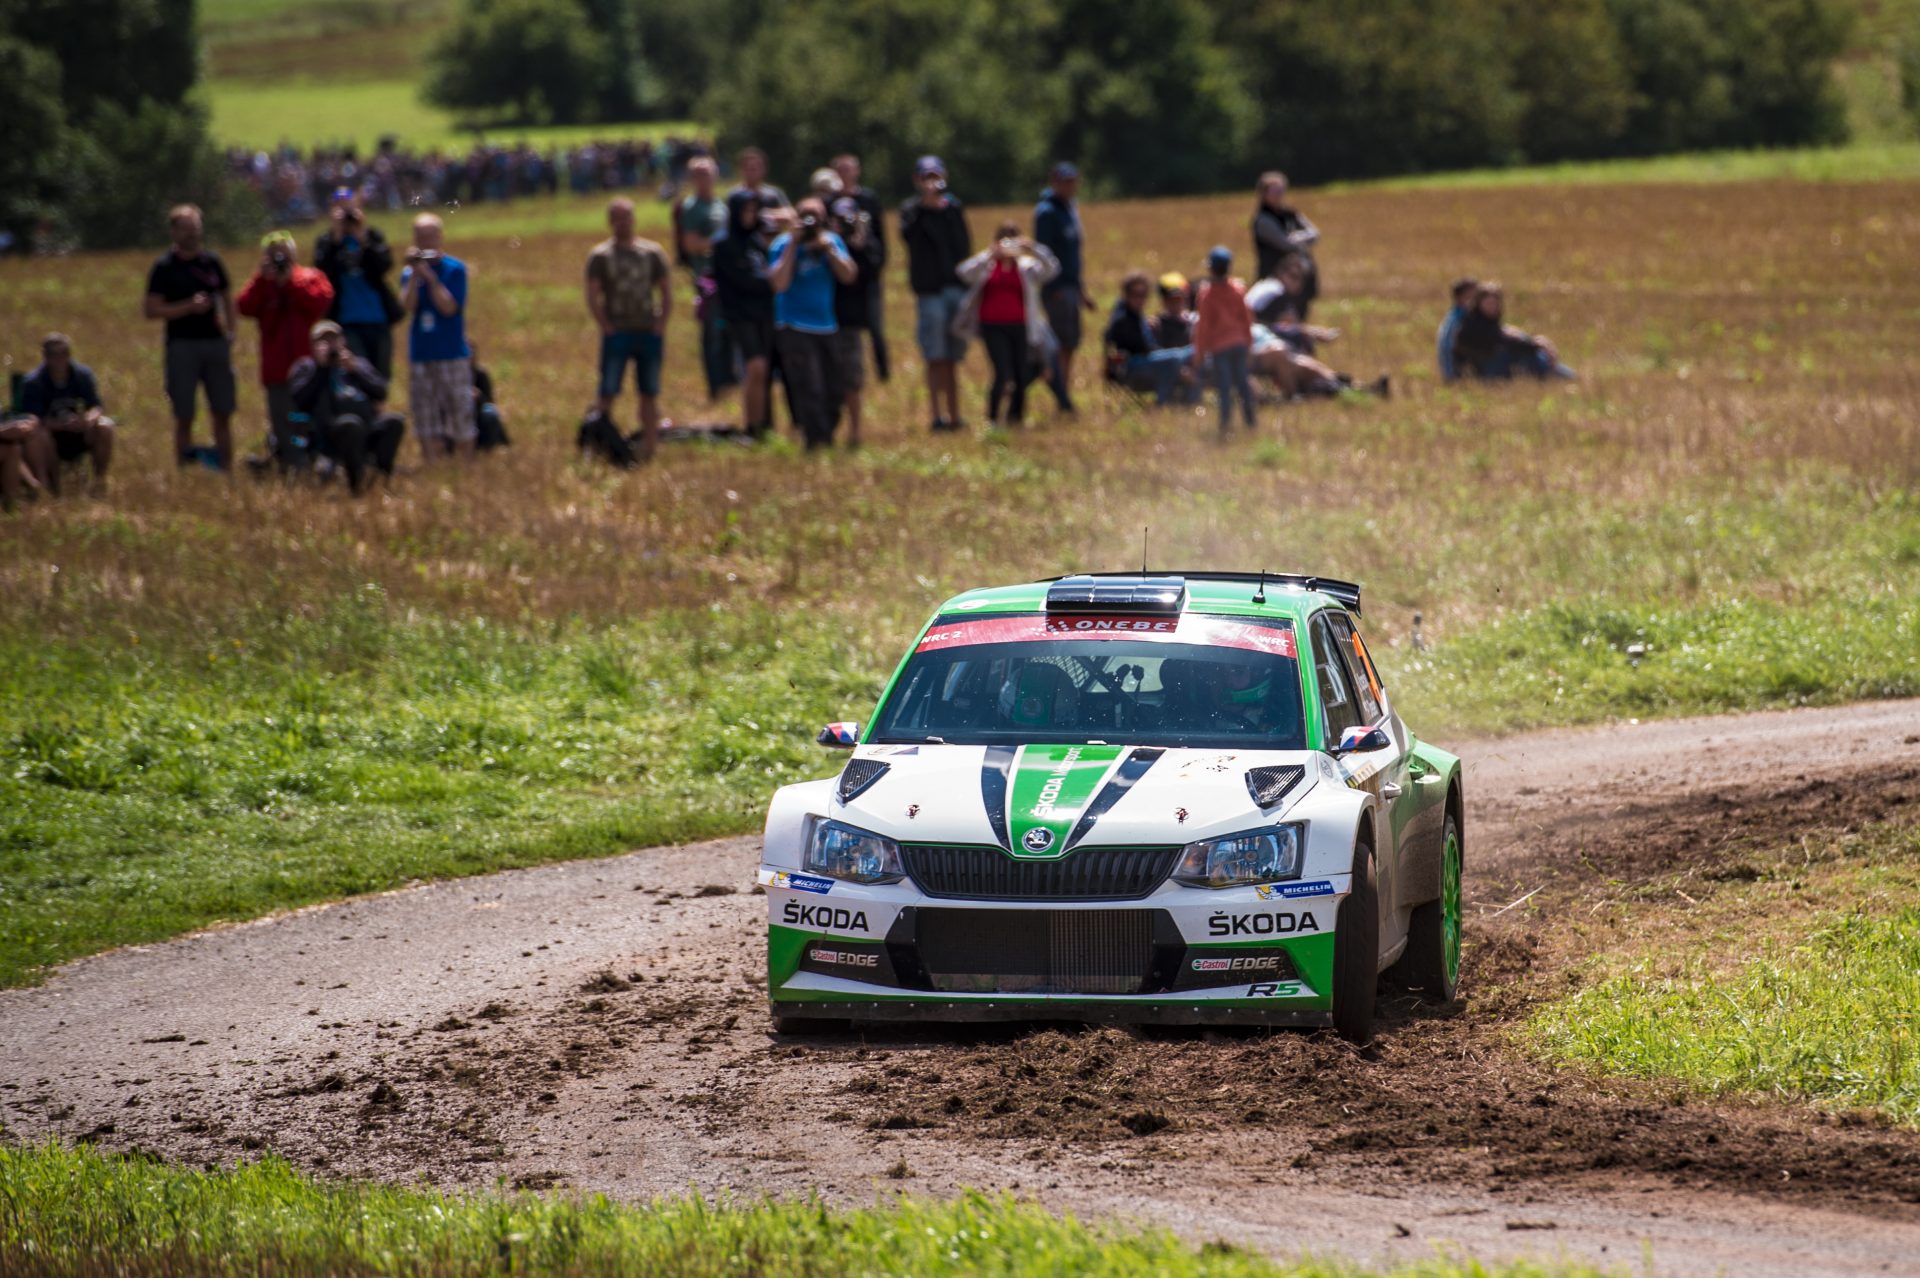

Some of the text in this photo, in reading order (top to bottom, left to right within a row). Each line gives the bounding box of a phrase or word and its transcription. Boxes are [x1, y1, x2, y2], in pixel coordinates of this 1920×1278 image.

[1075, 621, 1178, 631] ONEBE
[952, 630, 963, 639] 2
[1259, 635, 1290, 647] WRC
[1030, 778, 1066, 817] ŠKODA
[793, 878, 833, 890] MICHELIN
[1283, 884, 1332, 894] MICHELIN
[783, 899, 869, 932] ŠKODA
[1208, 911, 1319, 936] ŠKODA
[838, 952, 879, 967] EDGE
[1201, 956, 1280, 970] Castrol EDGE
[1247, 983, 1301, 997] R5
